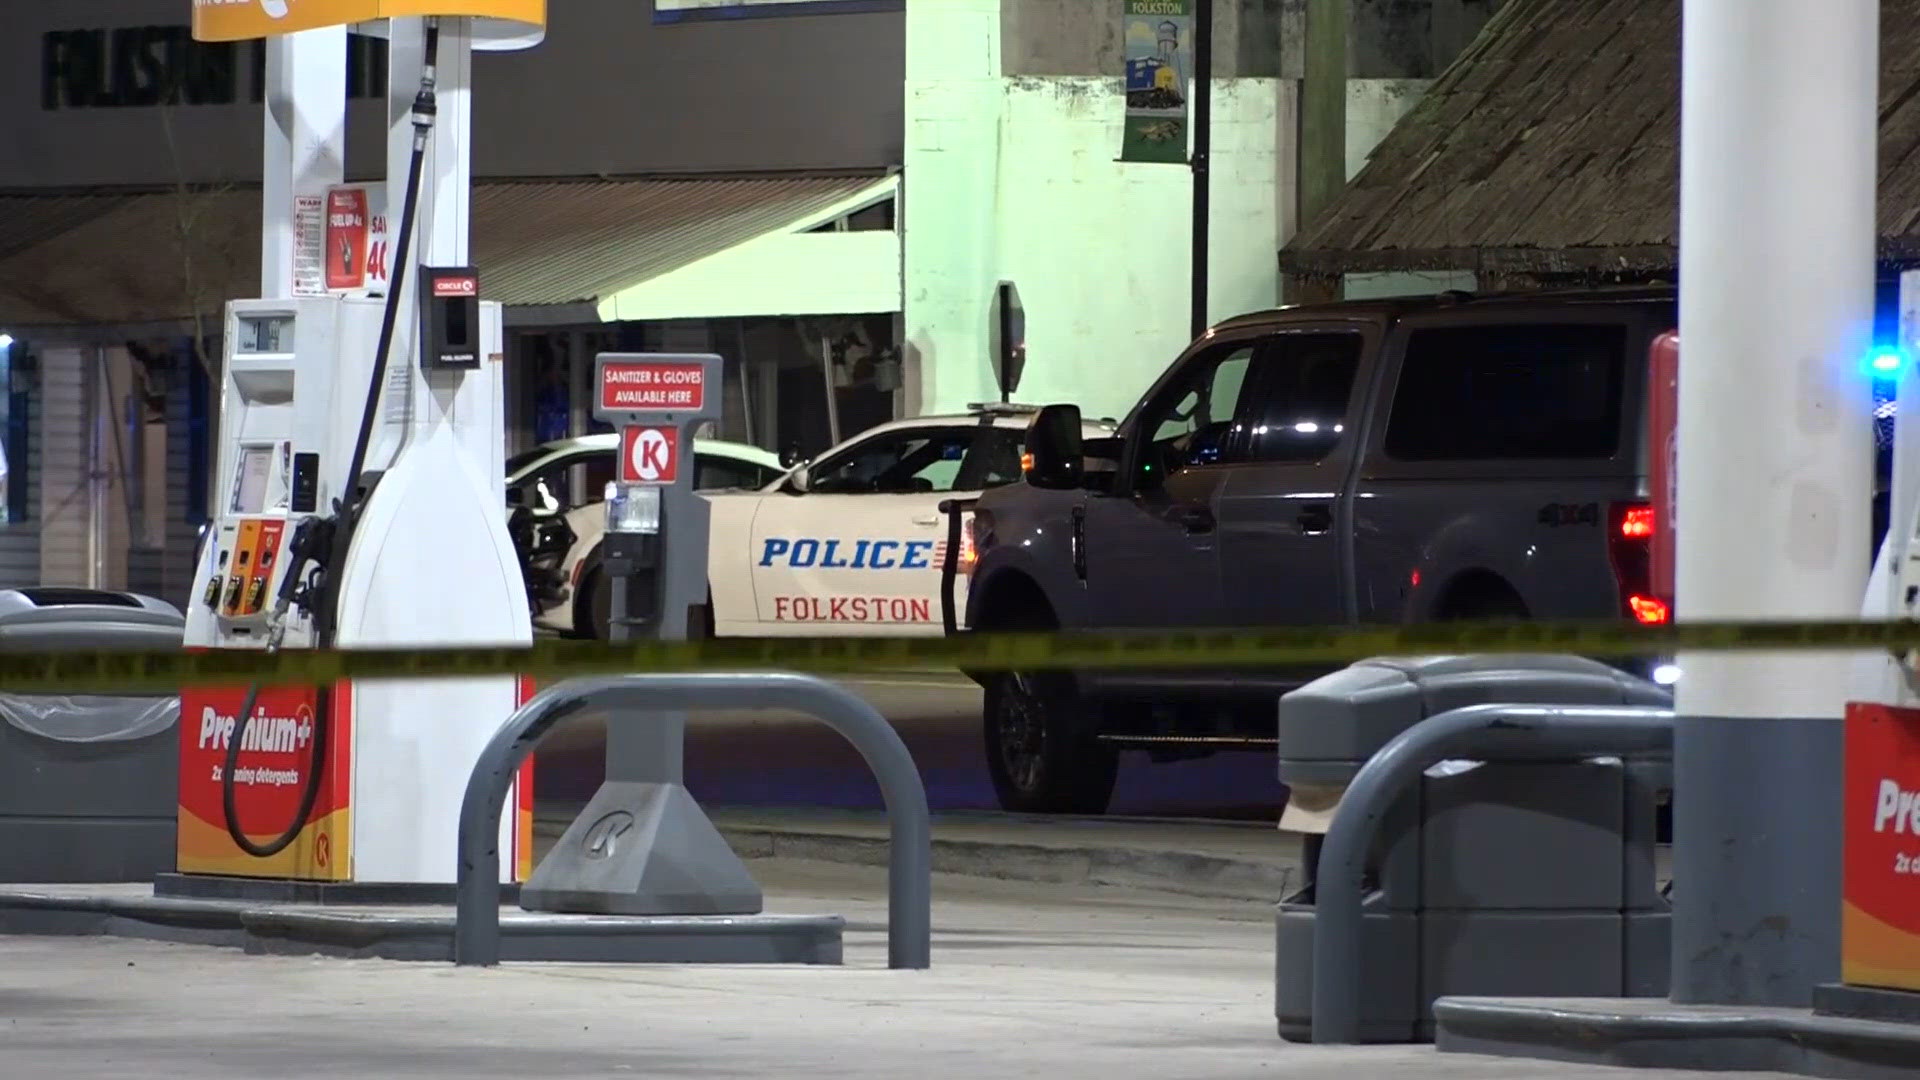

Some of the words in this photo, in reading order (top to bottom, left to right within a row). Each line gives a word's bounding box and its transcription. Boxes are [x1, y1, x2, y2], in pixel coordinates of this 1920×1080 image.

[1132, 2, 1182, 14] FOLKSTON
[605, 370, 651, 383] SANITIZER
[653, 372, 660, 383] &
[663, 370, 701, 384] GLOVES
[615, 391, 665, 403] AVAILABLE
[668, 391, 691, 403] HERE
[759, 538, 933, 569] POLICE
[775, 597, 930, 621] FOLKSTON
[234, 766, 255, 785] aning
[256, 767, 298, 787] detergents
